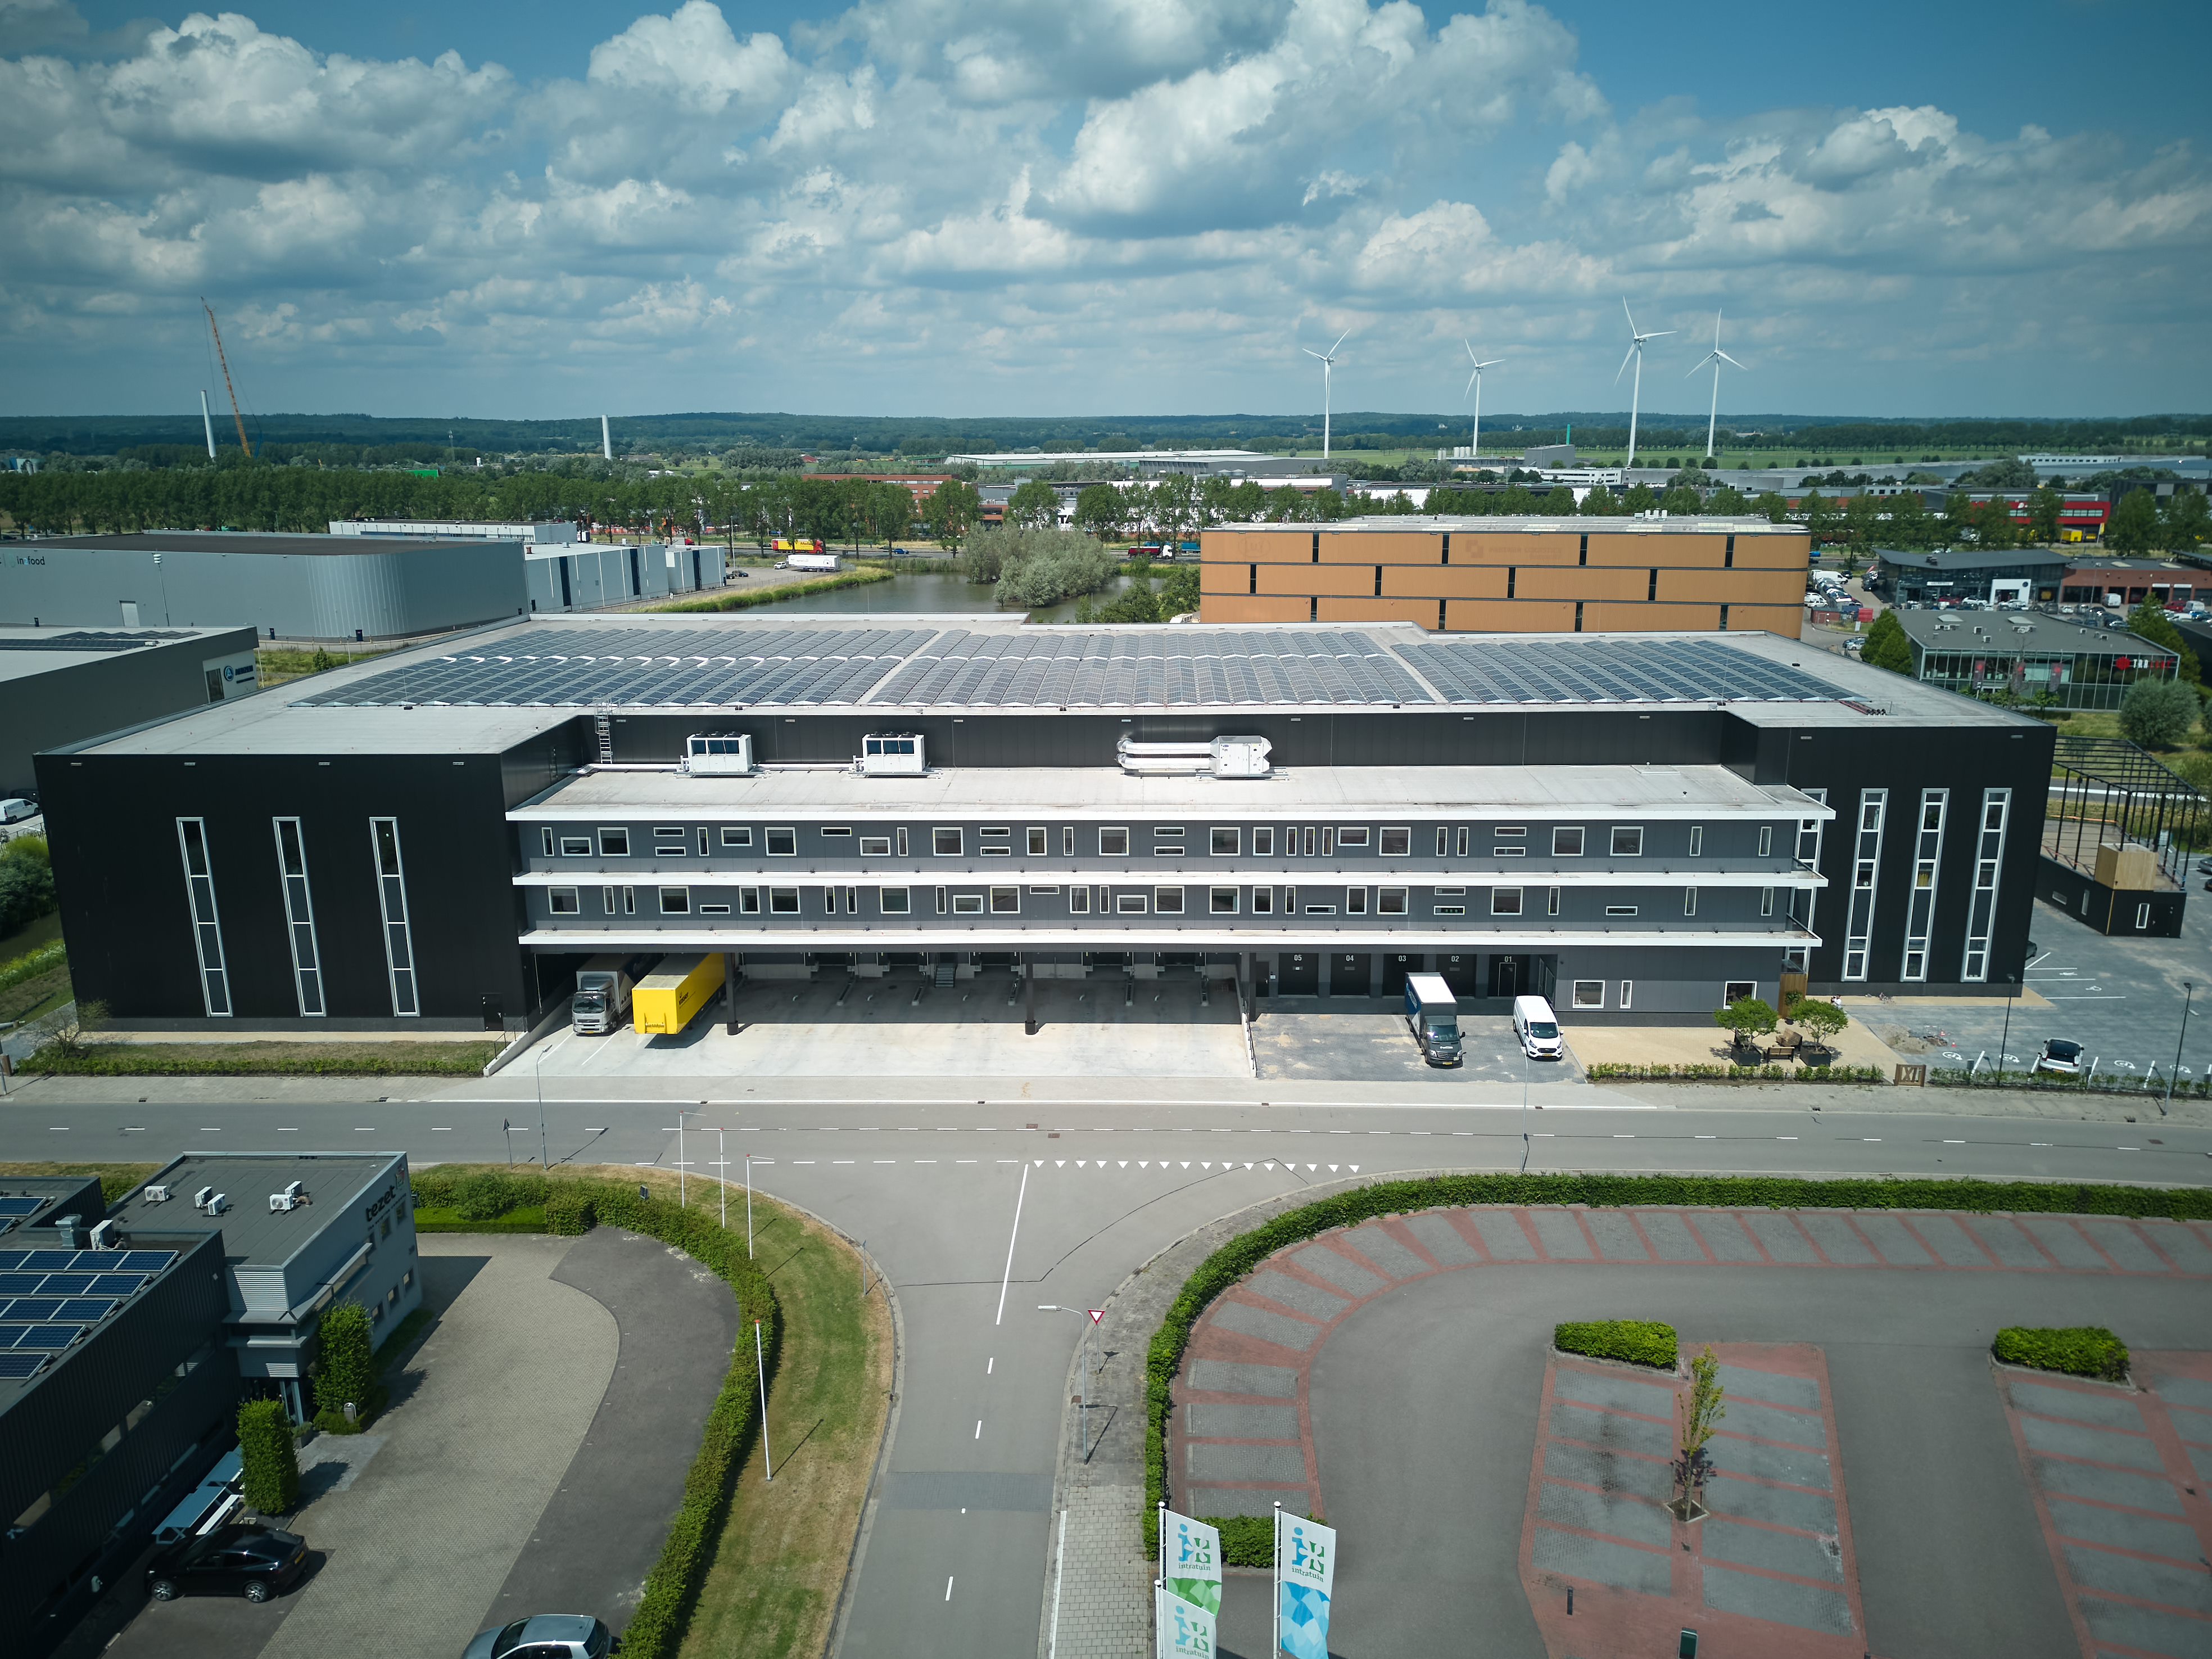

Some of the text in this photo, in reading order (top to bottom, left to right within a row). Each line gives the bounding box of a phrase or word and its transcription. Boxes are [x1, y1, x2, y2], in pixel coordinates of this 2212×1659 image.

[365, 1185, 396, 1222] tezet
[1292, 1566, 1324, 1583] intratuin
[1176, 1646, 1209, 1659] intratuin
